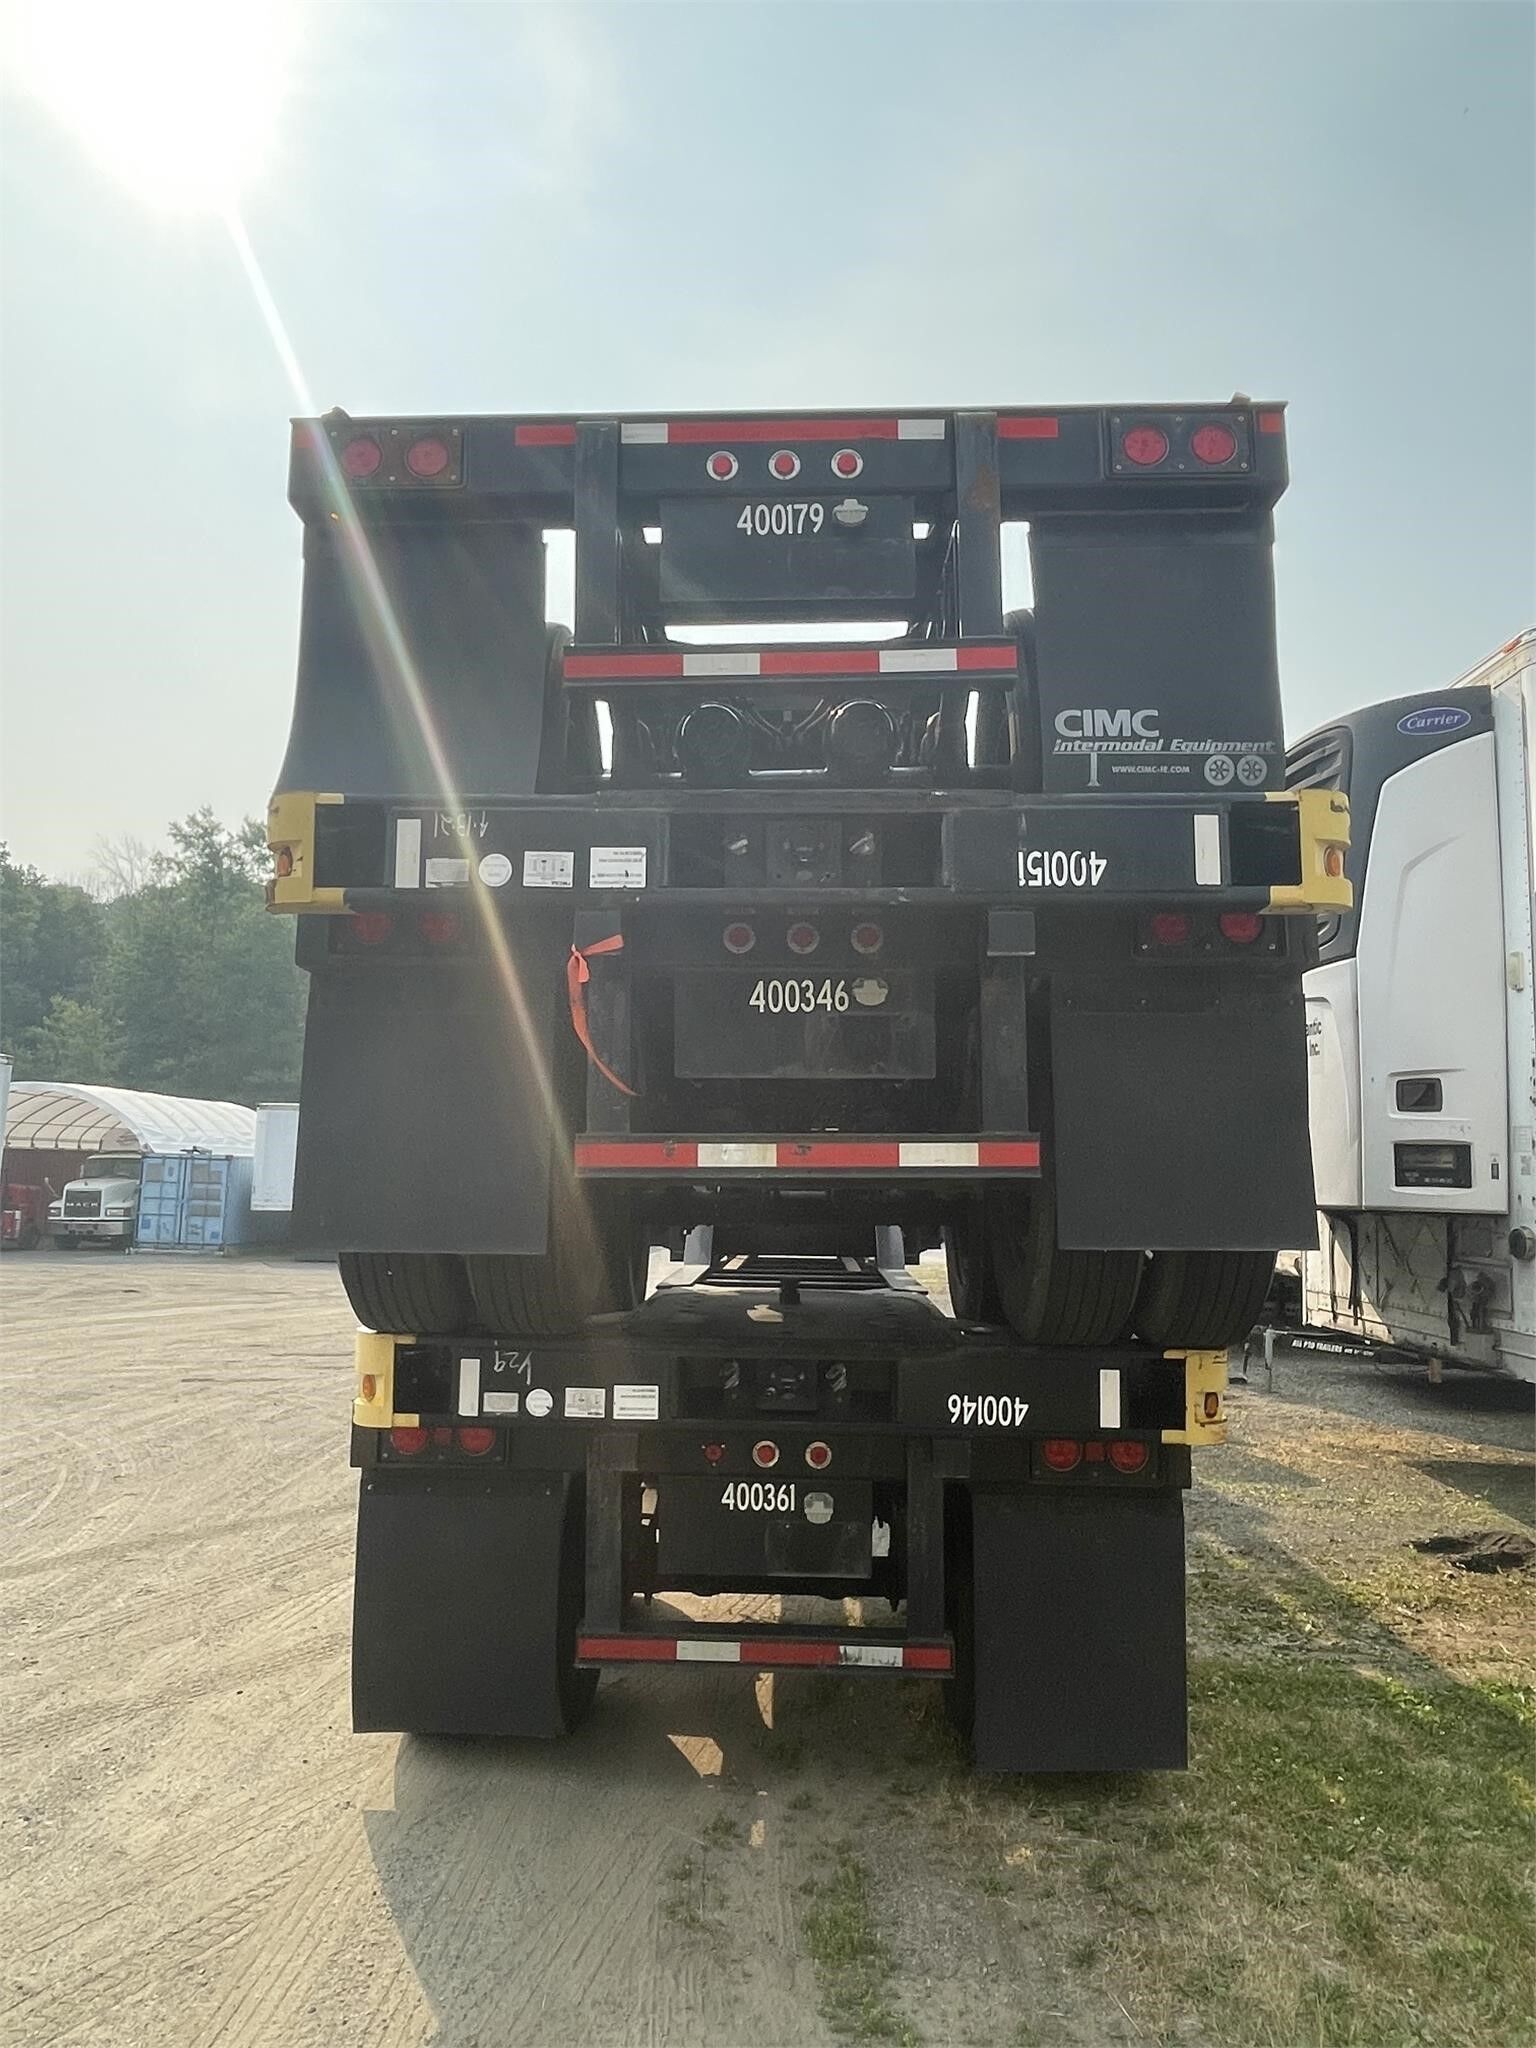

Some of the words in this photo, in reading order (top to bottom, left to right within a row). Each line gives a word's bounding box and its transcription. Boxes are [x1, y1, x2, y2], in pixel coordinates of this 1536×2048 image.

[736, 502, 824, 536] 400179
[1054, 709, 1160, 737] CIMC
[1407, 713, 1461, 730] Carrier
[1169, 738, 1277, 754] Equipment
[1018, 850, 1108, 887] 400151
[749, 979, 849, 1013] 400346
[947, 1394, 1029, 1427] 400146
[721, 1482, 796, 1512] 400361
